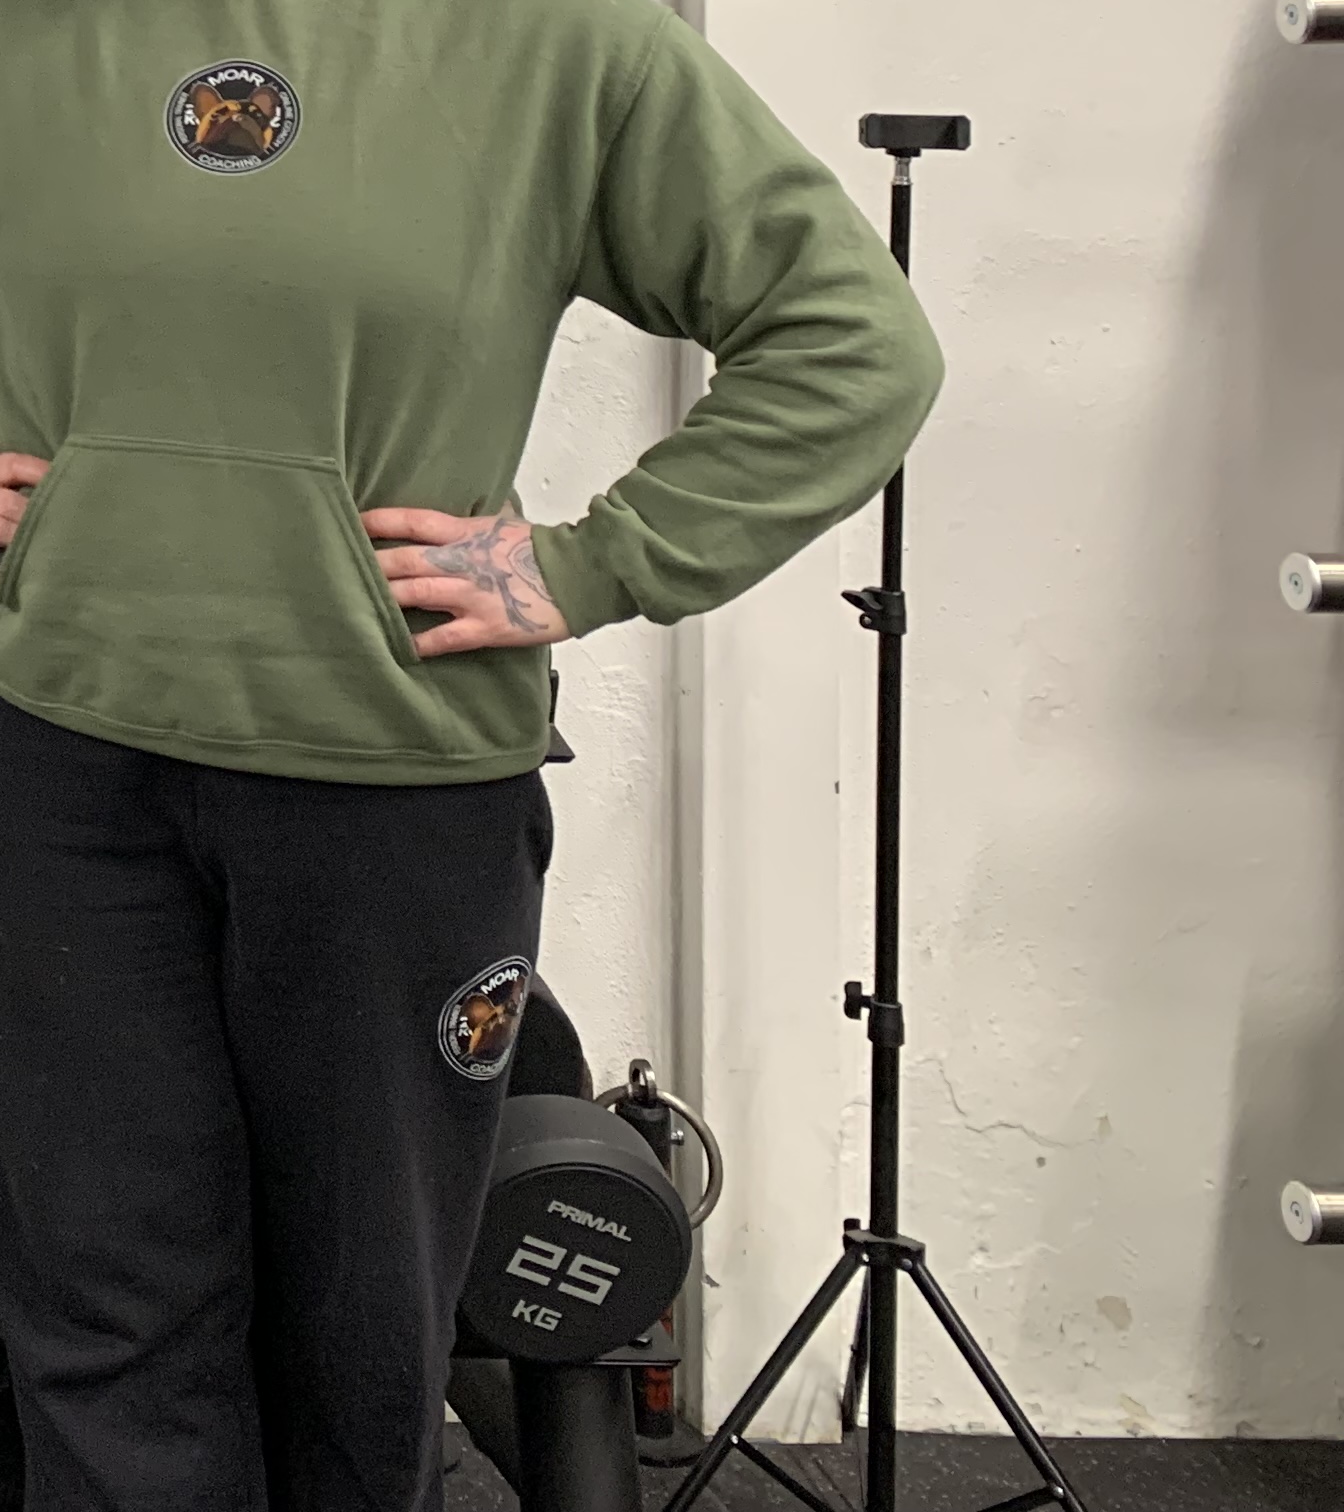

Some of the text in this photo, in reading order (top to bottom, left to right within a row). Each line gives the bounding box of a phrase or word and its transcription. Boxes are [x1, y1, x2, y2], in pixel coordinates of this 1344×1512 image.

[208, 68, 265, 87] MOAR
[198, 154, 263, 170] COACHING
[480, 968, 520, 995] MOAR
[548, 1200, 631, 1241] PRIMAL
[506, 1235, 620, 1305] 25
[512, 1300, 562, 1330] KG
